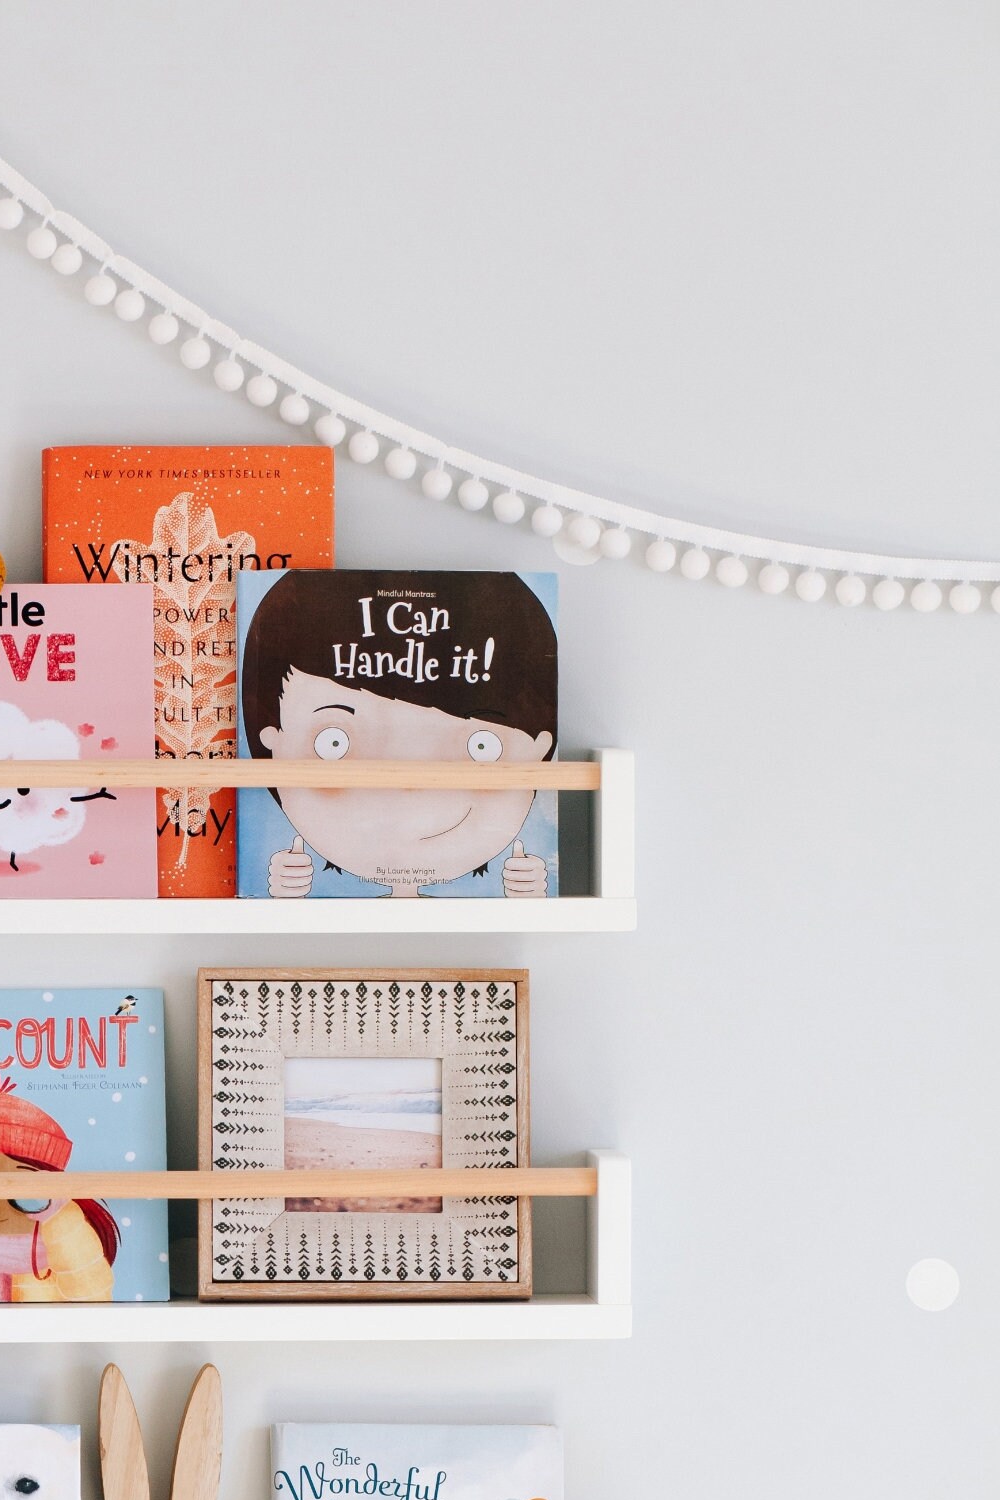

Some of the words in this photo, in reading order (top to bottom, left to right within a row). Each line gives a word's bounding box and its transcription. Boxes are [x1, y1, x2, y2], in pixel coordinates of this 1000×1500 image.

[84, 469, 112, 479] NEW
[118, 469, 153, 479] YORK
[159, 469, 198, 479] TIMES
[202, 469, 281, 479] BESTSELLER
[377, 589, 404, 598] Mindful
[405, 590, 436, 598] Mantras:
[358, 597, 376, 637] I
[386, 601, 450, 636] Can
[332, 638, 440, 683] Handle
[450, 637, 495, 684] it!
[172, 674, 194, 689] IN
[376, 866, 386, 875] By
[388, 867, 409, 875] Laurie
[412, 867, 436, 876] Wright
[402, 876, 411, 885] by
[332, 1448, 361, 1466] The
